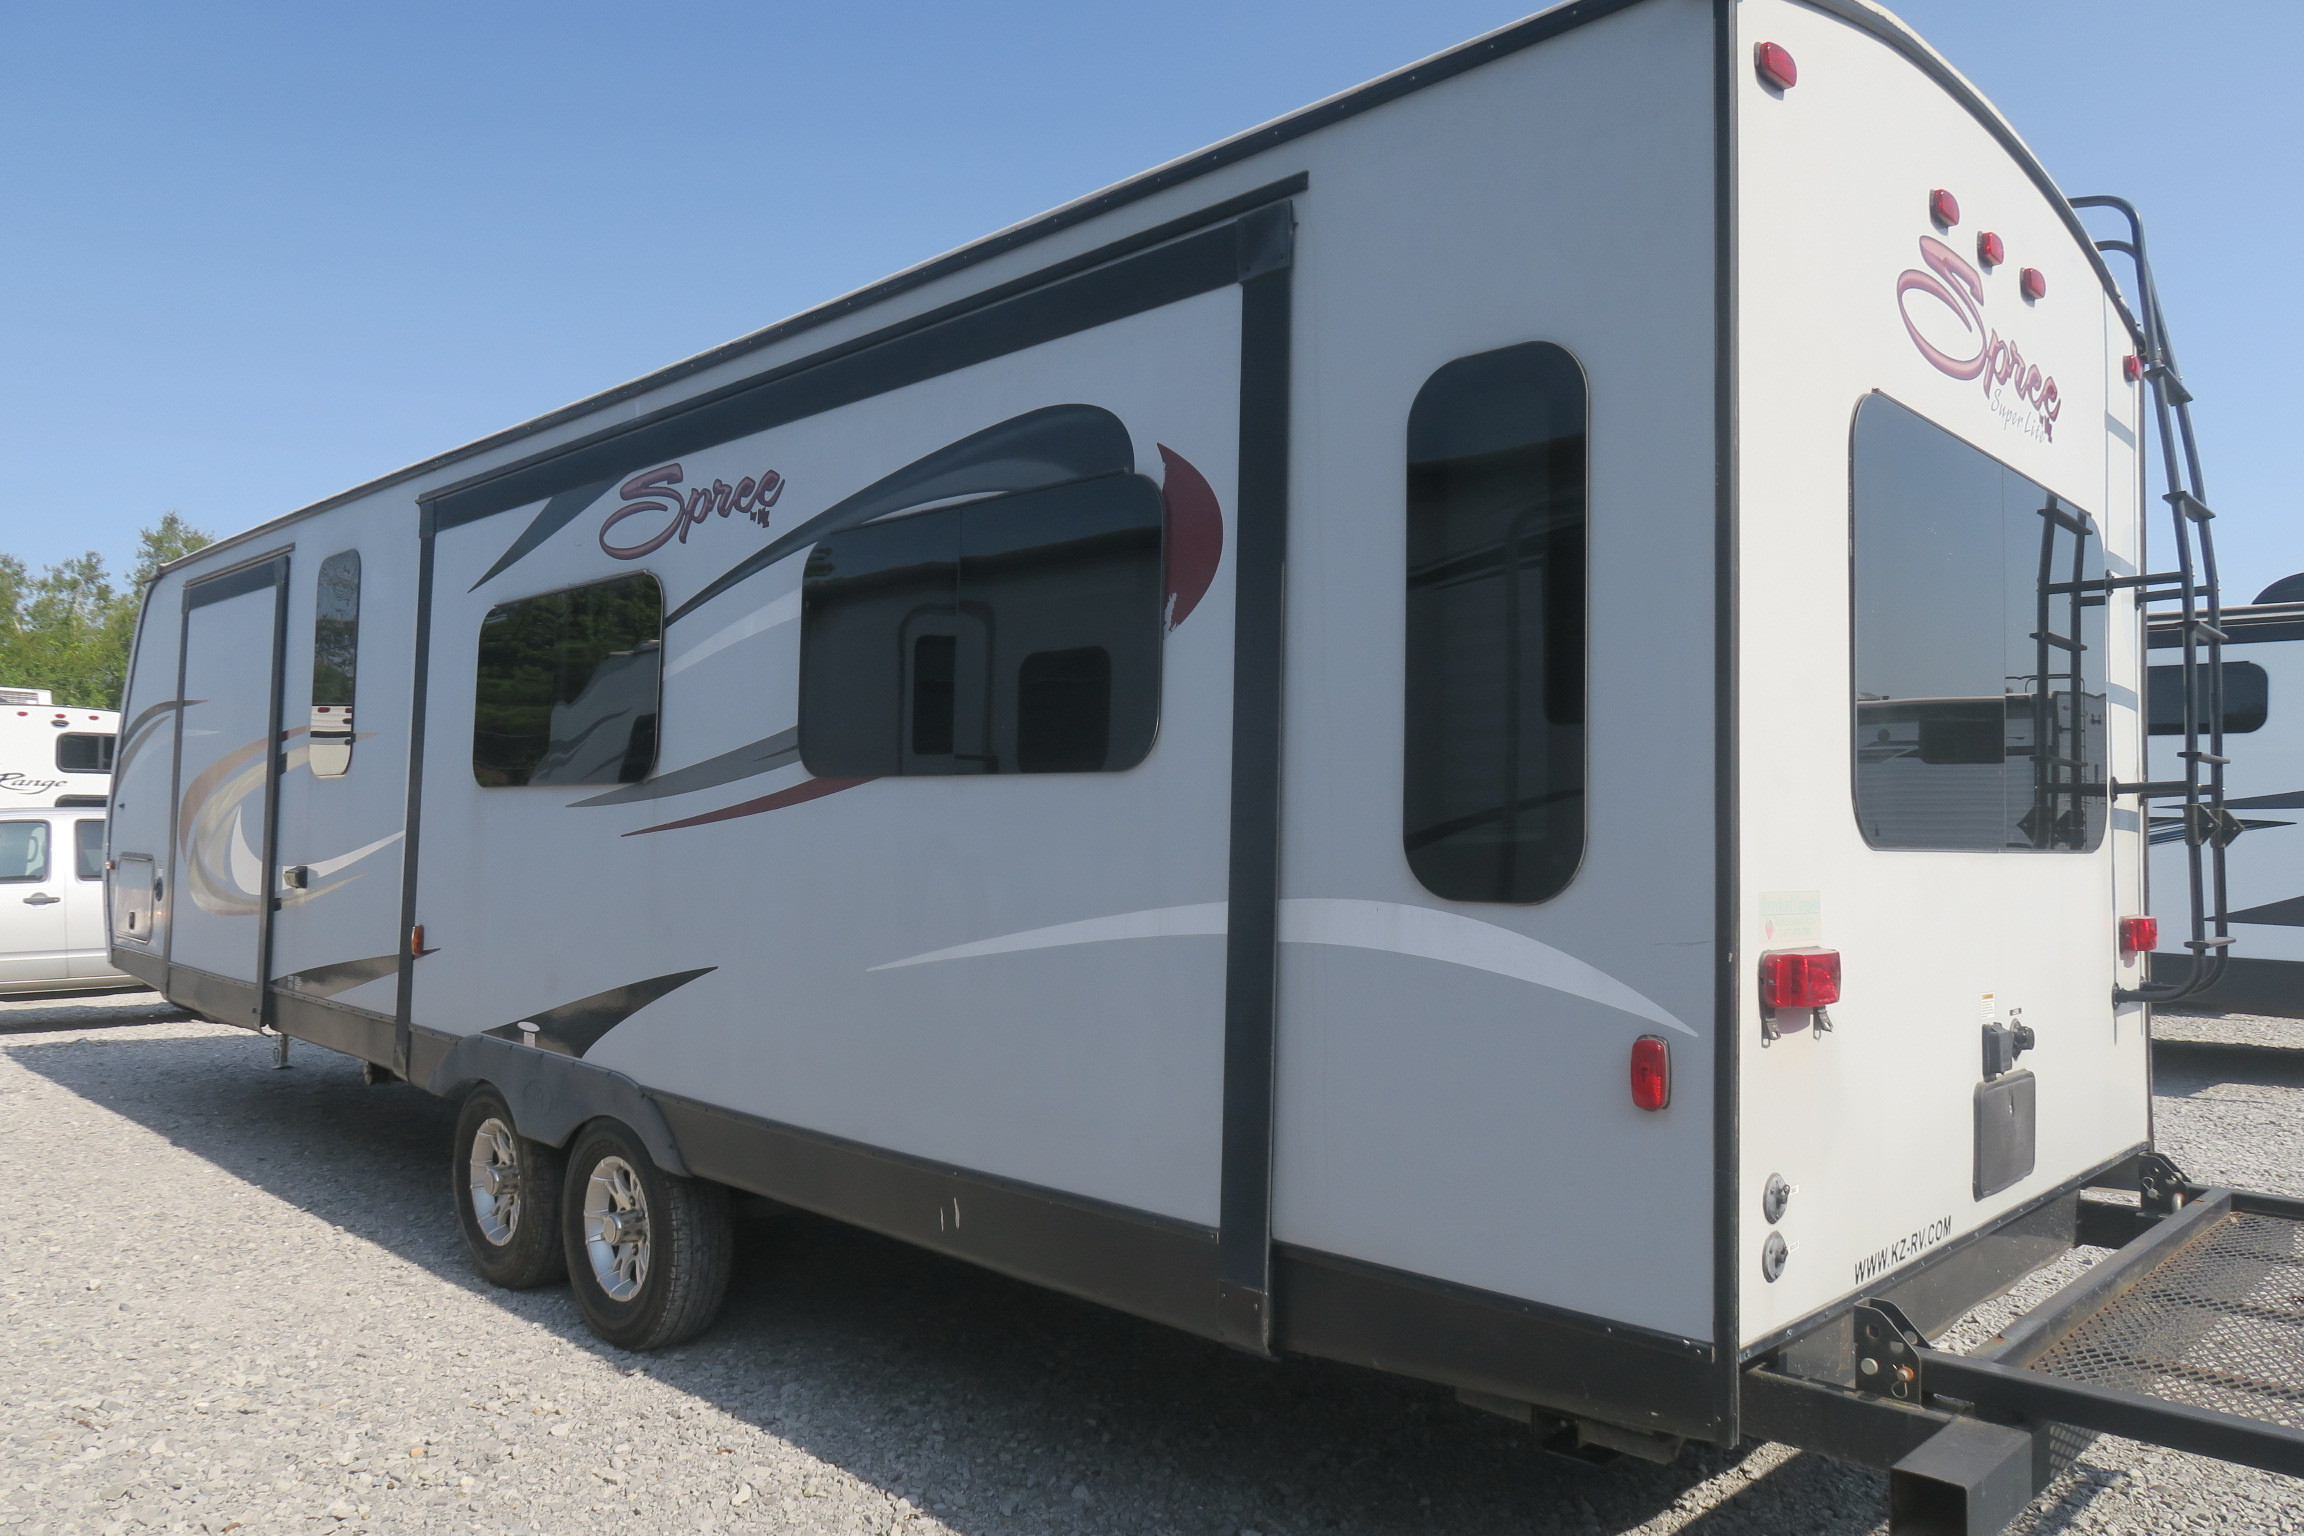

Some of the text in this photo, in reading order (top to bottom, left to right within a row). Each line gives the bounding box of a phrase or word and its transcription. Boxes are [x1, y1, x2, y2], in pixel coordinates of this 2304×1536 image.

[1897, 235, 2061, 422] Spree
[1991, 388, 2046, 443] Super Lite
[599, 463, 786, 560] Spree
[1854, 1215, 1952, 1285] WWW.KZ-RV.COM
